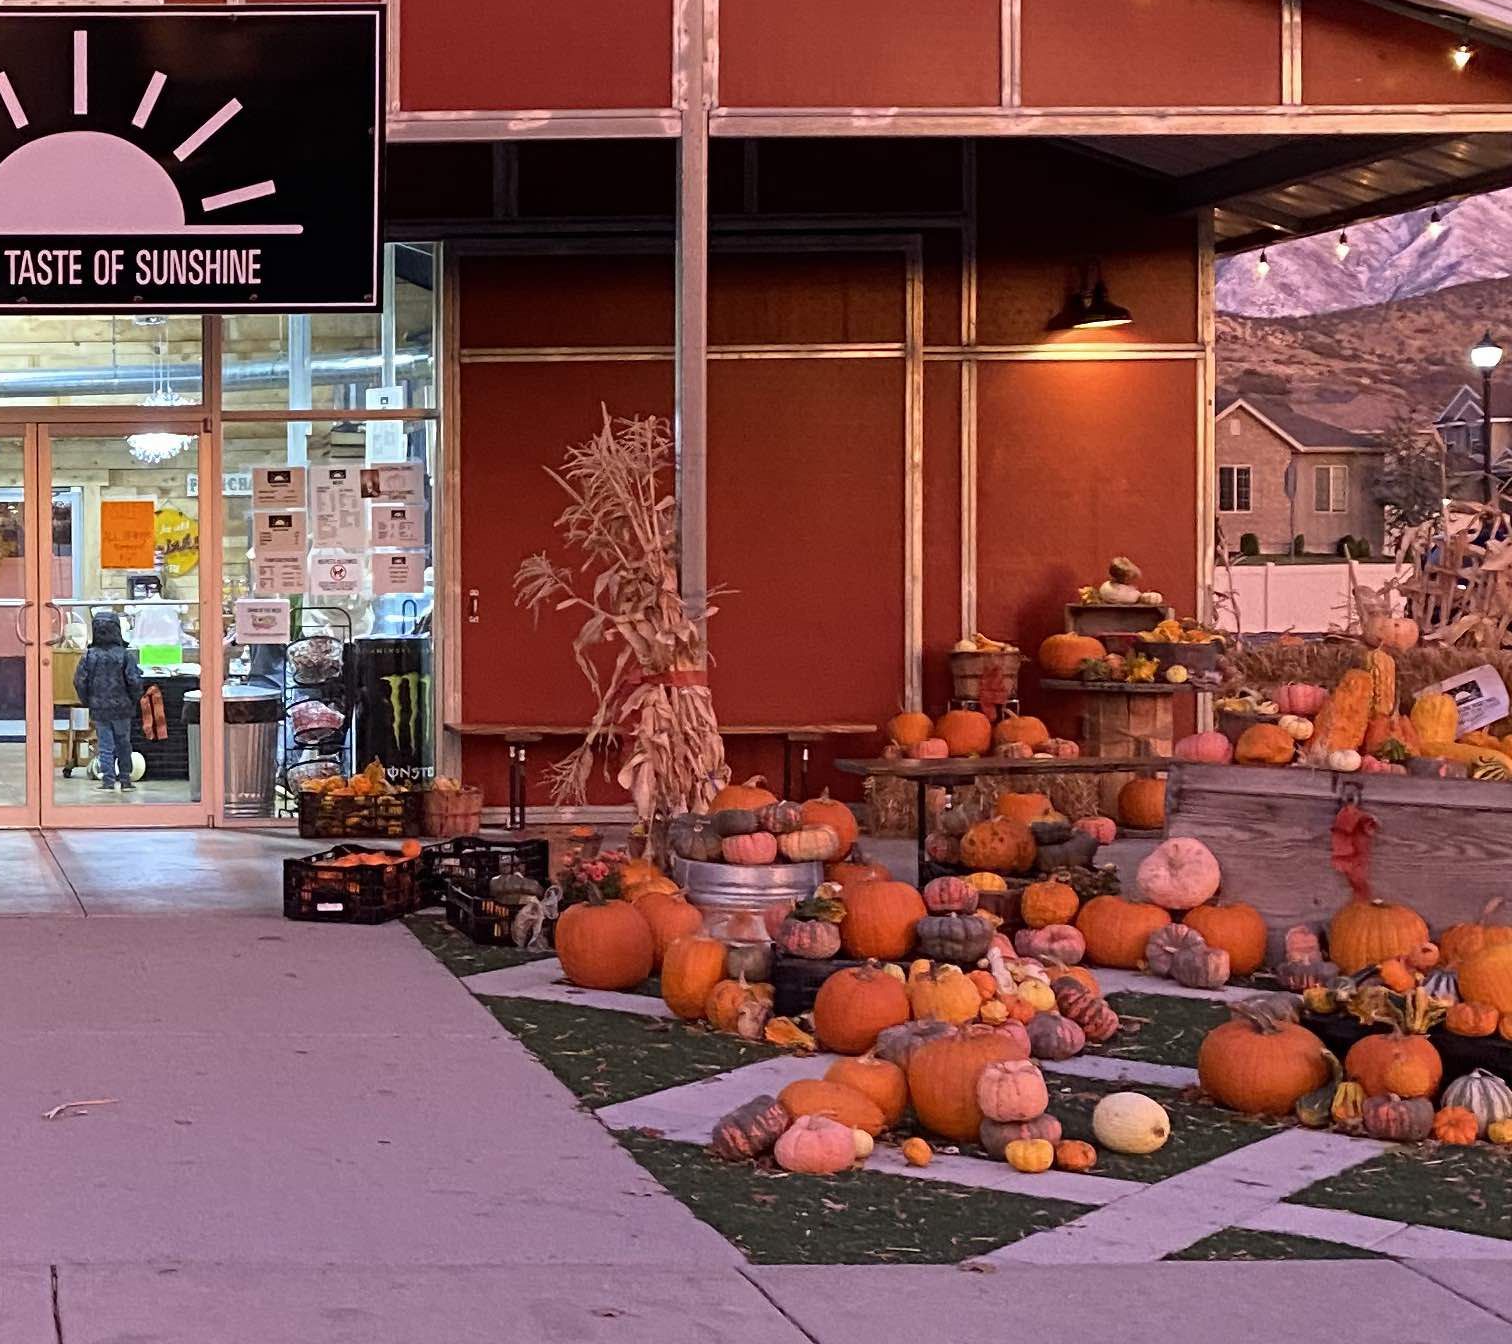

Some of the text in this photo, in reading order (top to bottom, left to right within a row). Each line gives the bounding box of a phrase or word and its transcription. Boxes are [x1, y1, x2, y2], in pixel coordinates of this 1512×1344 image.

[4, 249, 82, 286] TASTE
[93, 249, 125, 286] OF
[135, 248, 262, 285] SUNSHINE
